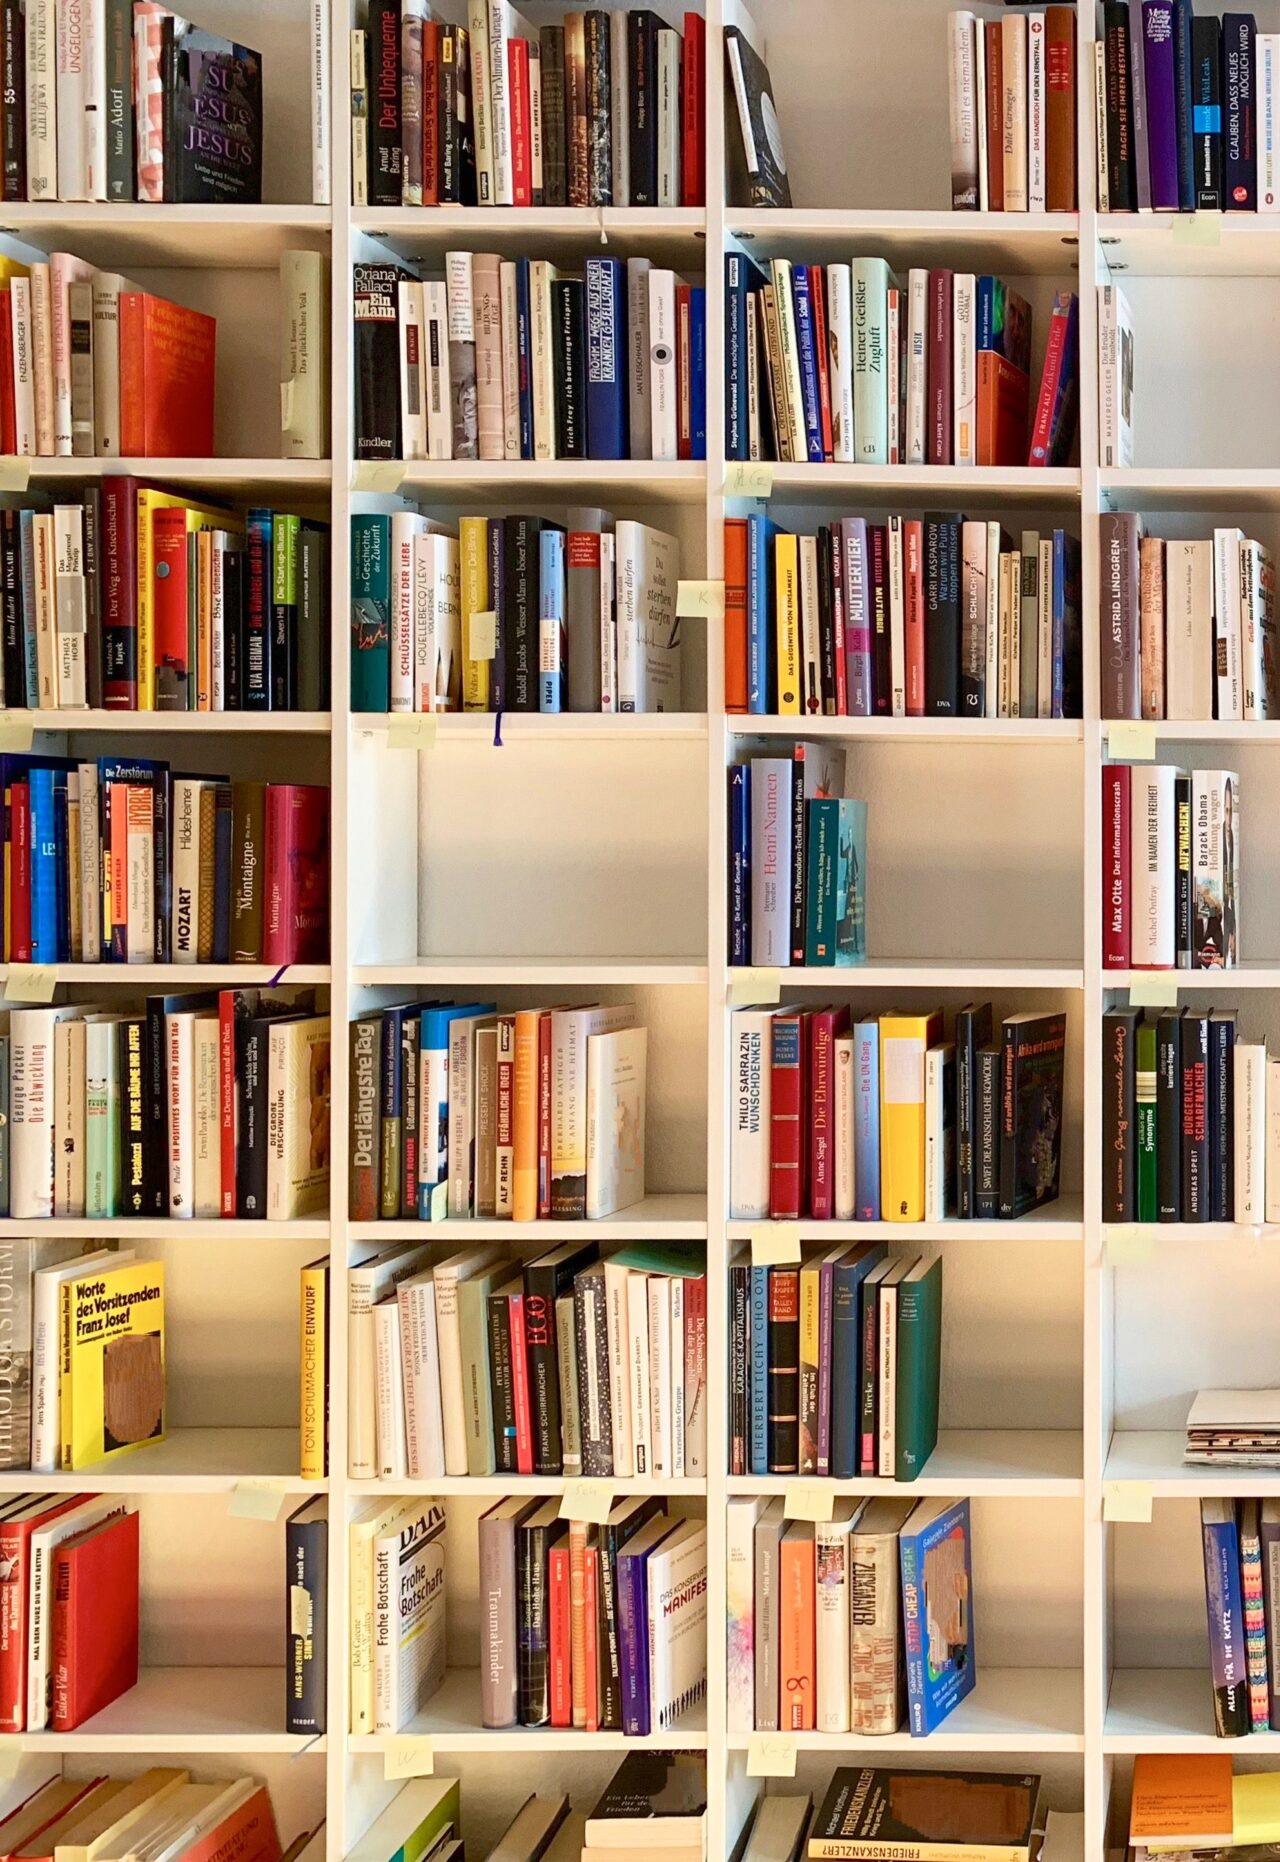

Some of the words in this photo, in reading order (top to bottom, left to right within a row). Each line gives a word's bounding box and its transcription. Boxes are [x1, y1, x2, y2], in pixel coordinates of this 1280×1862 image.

[1117, 27, 1125, 74] BESTATTER
[1240, 25, 1249, 50] WIRD
[379, 11, 397, 99] Unbequeme
[1230, 52, 1238, 82] NEUES
[1239, 53, 1249, 98] MÖGLICH
[111, 89, 124, 127] Adorf
[1230, 86, 1238, 109] DASS
[380, 104, 397, 128] Der
[115, 131, 123, 155] Mario
[1230, 113, 1239, 159] GLAUBEN,
[380, 147, 390, 173] Arnulf
[390, 147, 401, 173] Baring
[590, 264, 599, 289] EINER
[16, 285, 25, 318] TUMULT
[355, 300, 396, 318] Mann
[370, 293, 391, 307] Ein
[590, 292, 600, 309] AUS
[601, 269, 612, 334] GESELLSCHAFT
[856, 279, 866, 327] Geißler
[590, 311, 600, 337] WEGE
[18, 321, 27, 382] ENZENSBERGER
[590, 346, 600, 378] FROMM
[602, 337, 612, 378] KRANKEN
[730, 334, 738, 367] erschöpfte
[856, 330, 866, 372] Heiner
[869, 326, 882, 373] Zugluft
[358, 437, 392, 447] Kindler
[107, 494, 116, 555] Knechtschaft
[939, 524, 947, 548] Putin
[362, 529, 371, 579] Geschichte
[372, 524, 380, 560] Zukunft
[401, 543, 409, 567] LIEBE
[929, 524, 937, 577] KASPAROW
[939, 551, 947, 565] wir
[949, 524, 957, 560] müssen
[624, 559, 633, 587] dürfen
[847, 538, 863, 621] MUTTERTIER
[939, 568, 948, 601] Warum
[950, 563, 958, 602] stoppen
[1111, 539, 1120, 597] LINDGREN
[108, 576, 120, 598] Weg
[929, 580, 937, 610] GARRI
[109, 601, 118, 616] Der
[625, 590, 633, 622] sterben
[1112, 600, 1121, 643] ASTRID
[400, 593, 410, 676] SCHLÜSSELSÄTZE
[250, 636, 262, 670] HERMAN
[250, 673, 263, 688] EVA
[129, 787, 151, 826] HYBRIS
[765, 773, 777, 830] Nannen
[1148, 785, 1158, 816] FREIHEIT
[1198, 795, 1207, 827] Obama
[1211, 790, 1220, 821] wagen
[180, 787, 192, 850] Hildesheimer
[1113, 782, 1121, 858] Informationscrash
[1148, 818, 1158, 832] DER
[1148, 834, 1158, 860] NAMEN
[1179, 802, 1189, 871] AUFWACHEN!
[1199, 832, 1208, 866] Barack
[1209, 824, 1219, 871] Hoffnung
[765, 834, 777, 875] Henri
[795, 822, 803, 889] Pomodoro-Technik
[1113, 860, 1121, 875] Der
[1148, 862, 1158, 872] IM
[240, 842, 256, 910] Montaigne
[1112, 880, 1122, 905] Otte
[178, 888, 190, 951] MOZART
[270, 883, 281, 934] Montaigne
[1149, 886, 1159, 919] Onfray
[1112, 908, 1122, 932] Max
[1149, 921, 1157, 946] Michel
[354, 1024, 374, 1057] Tag
[13, 1045, 24, 1080] Packer
[29, 1045, 46, 1102] Abwicklung
[739, 1032, 749, 1092] SARRAZIN
[353, 1058, 375, 1132] längste
[750, 1032, 761, 1133] WUNSCHDENKEN
[13, 1086, 25, 1122] George
[29, 1107, 44, 1122] Die
[739, 1097, 749, 1130] THILO
[1183, 1068, 1193, 1135] BÜRGERLICHE
[1195, 1062, 1205, 1141] SCHARFMACHER
[277, 1089, 285, 1159] VERSCHWULUNG
[1146, 1109, 1154, 1151] Synonyme
[354, 1134, 372, 1166] Der
[500, 1156, 508, 1182] REHN
[754, 1268, 763, 1295] OYU
[305, 1285, 316, 1334] EINWURF
[754, 1301, 763, 1330] CHO
[305, 1337, 316, 1422] SCHUMACHER
[755, 1343, 763, 1384] TICHY
[538, 1363, 548, 1426] SCHIRRMACHER
[864, 1382, 873, 1415] Türcke
[755, 1388, 763, 1450] HERBERT
[306, 1427, 315, 1454] TONI
[542, 1430, 550, 1457] FRANK
[376, 1551, 388, 1609] Botschaft
[532, 1562, 540, 1584] Haus
[904, 1547, 914, 1582] SPEAK
[532, 1587, 540, 1609] Hohe
[905, 1583, 918, 1618] CHEAP
[377, 1613, 389, 1646] Frohe
[489, 1588, 503, 1685] Traumakinder
[532, 1611, 540, 1628] Das
[907, 1620, 920, 1652] STOP
[909, 1662, 917, 1694] Gabriele
[915, 1660, 924, 1694] Zienterra
